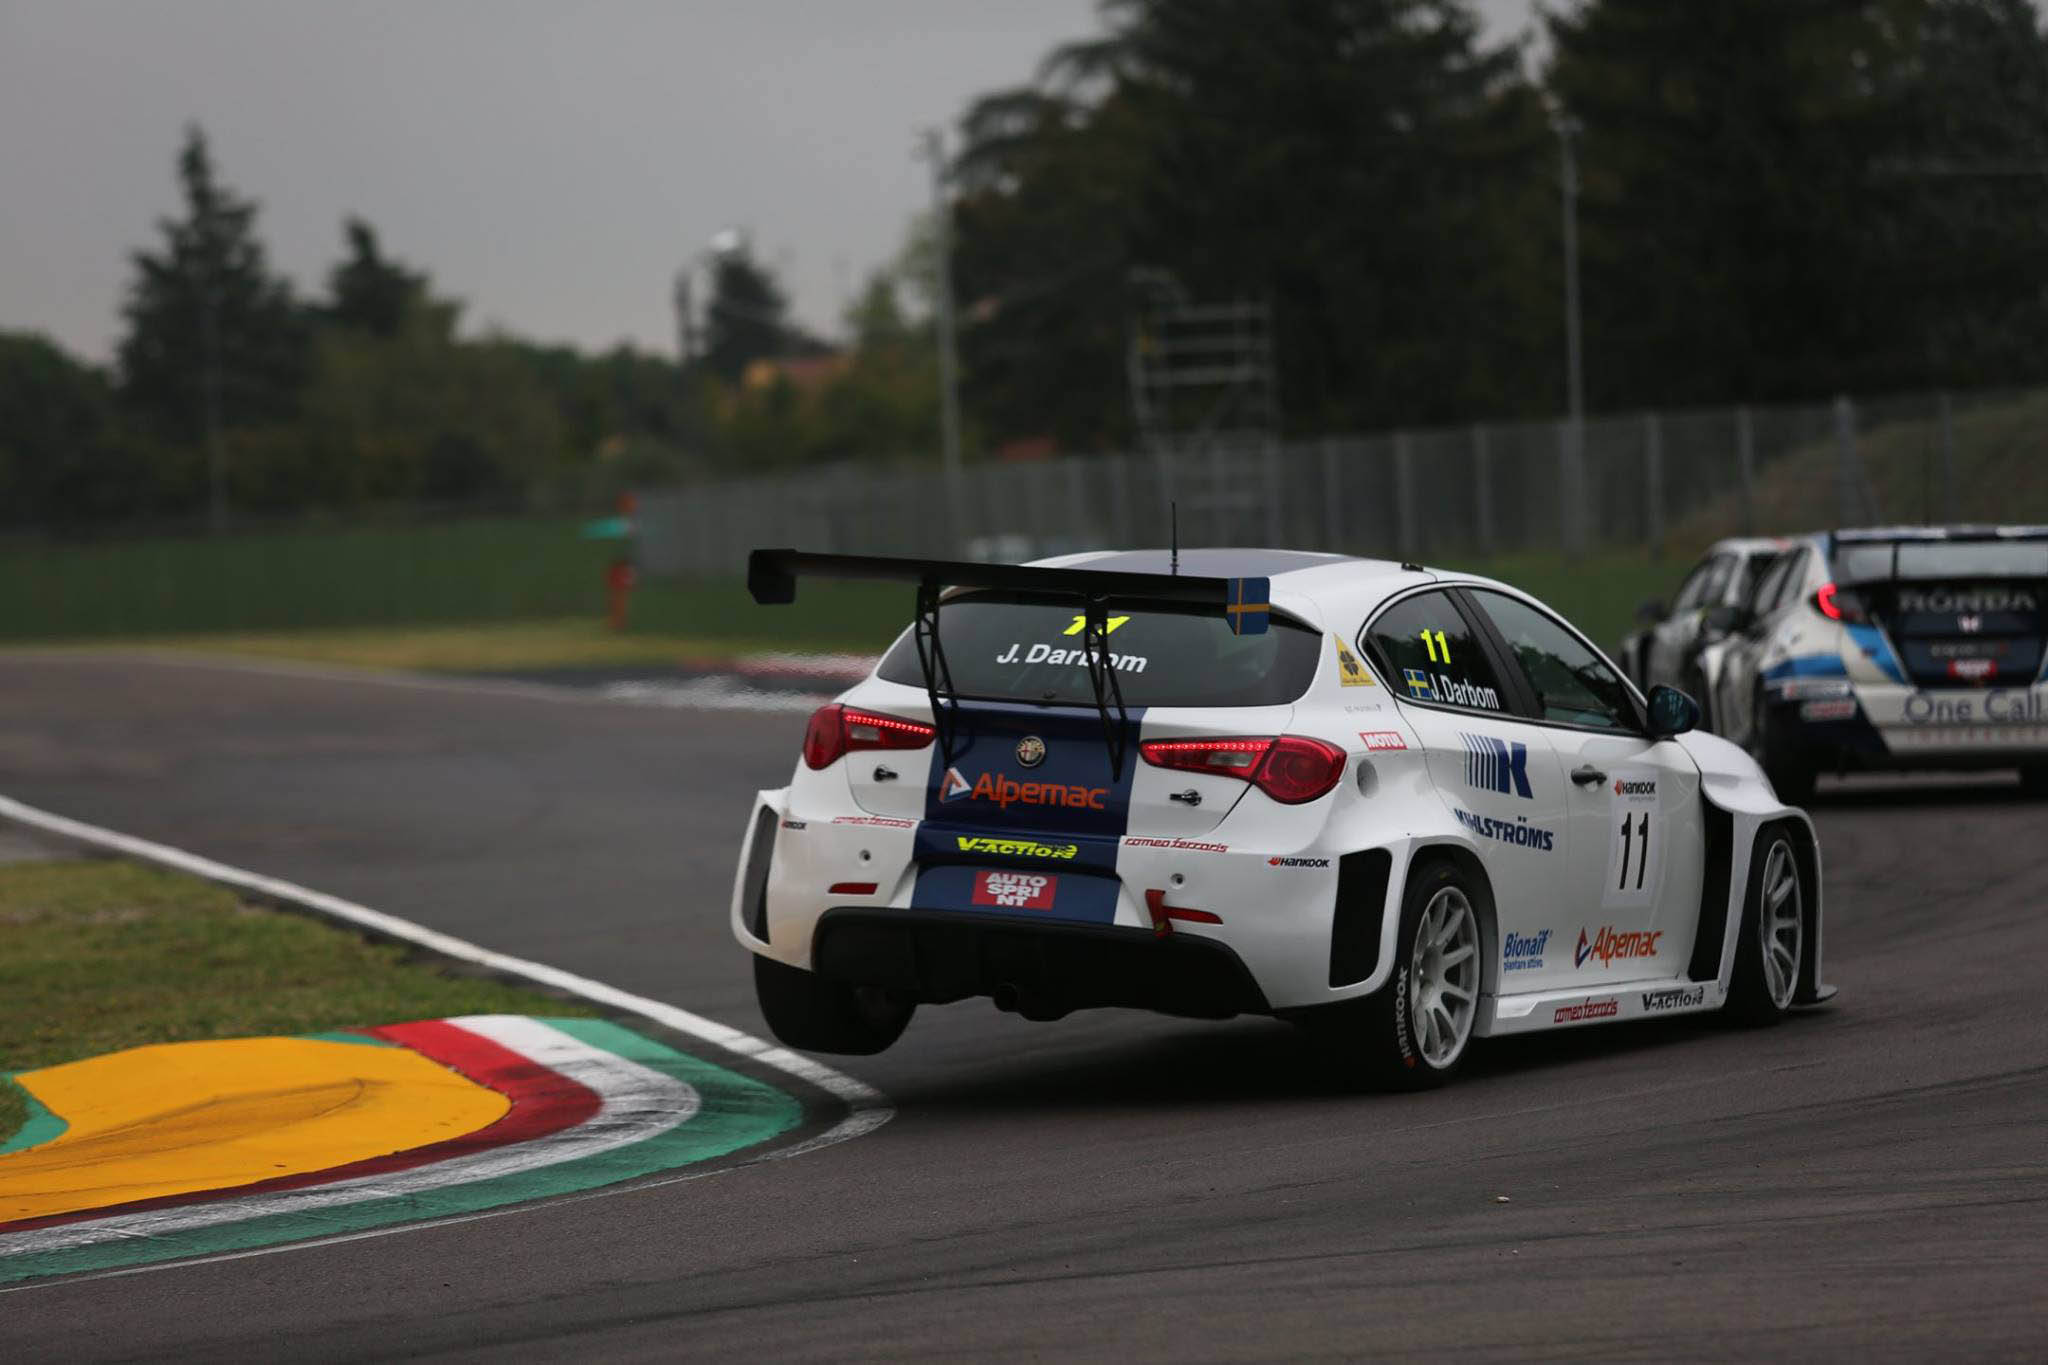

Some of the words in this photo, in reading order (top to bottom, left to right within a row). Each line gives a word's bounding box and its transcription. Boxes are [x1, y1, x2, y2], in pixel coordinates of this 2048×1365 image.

[996, 644, 1021, 664] J.
[1420, 629, 1451, 664] 11
[1904, 693, 1972, 723] One
[1984, 688, 2042, 722] Call
[971, 772, 1105, 810] Alpemac
[1620, 812, 1649, 890] 11
[985, 873, 1047, 887] AUTO
[987, 884, 1041, 898] SPRI
[996, 895, 1028, 907] NT
[1591, 925, 1665, 968] Alpemac
